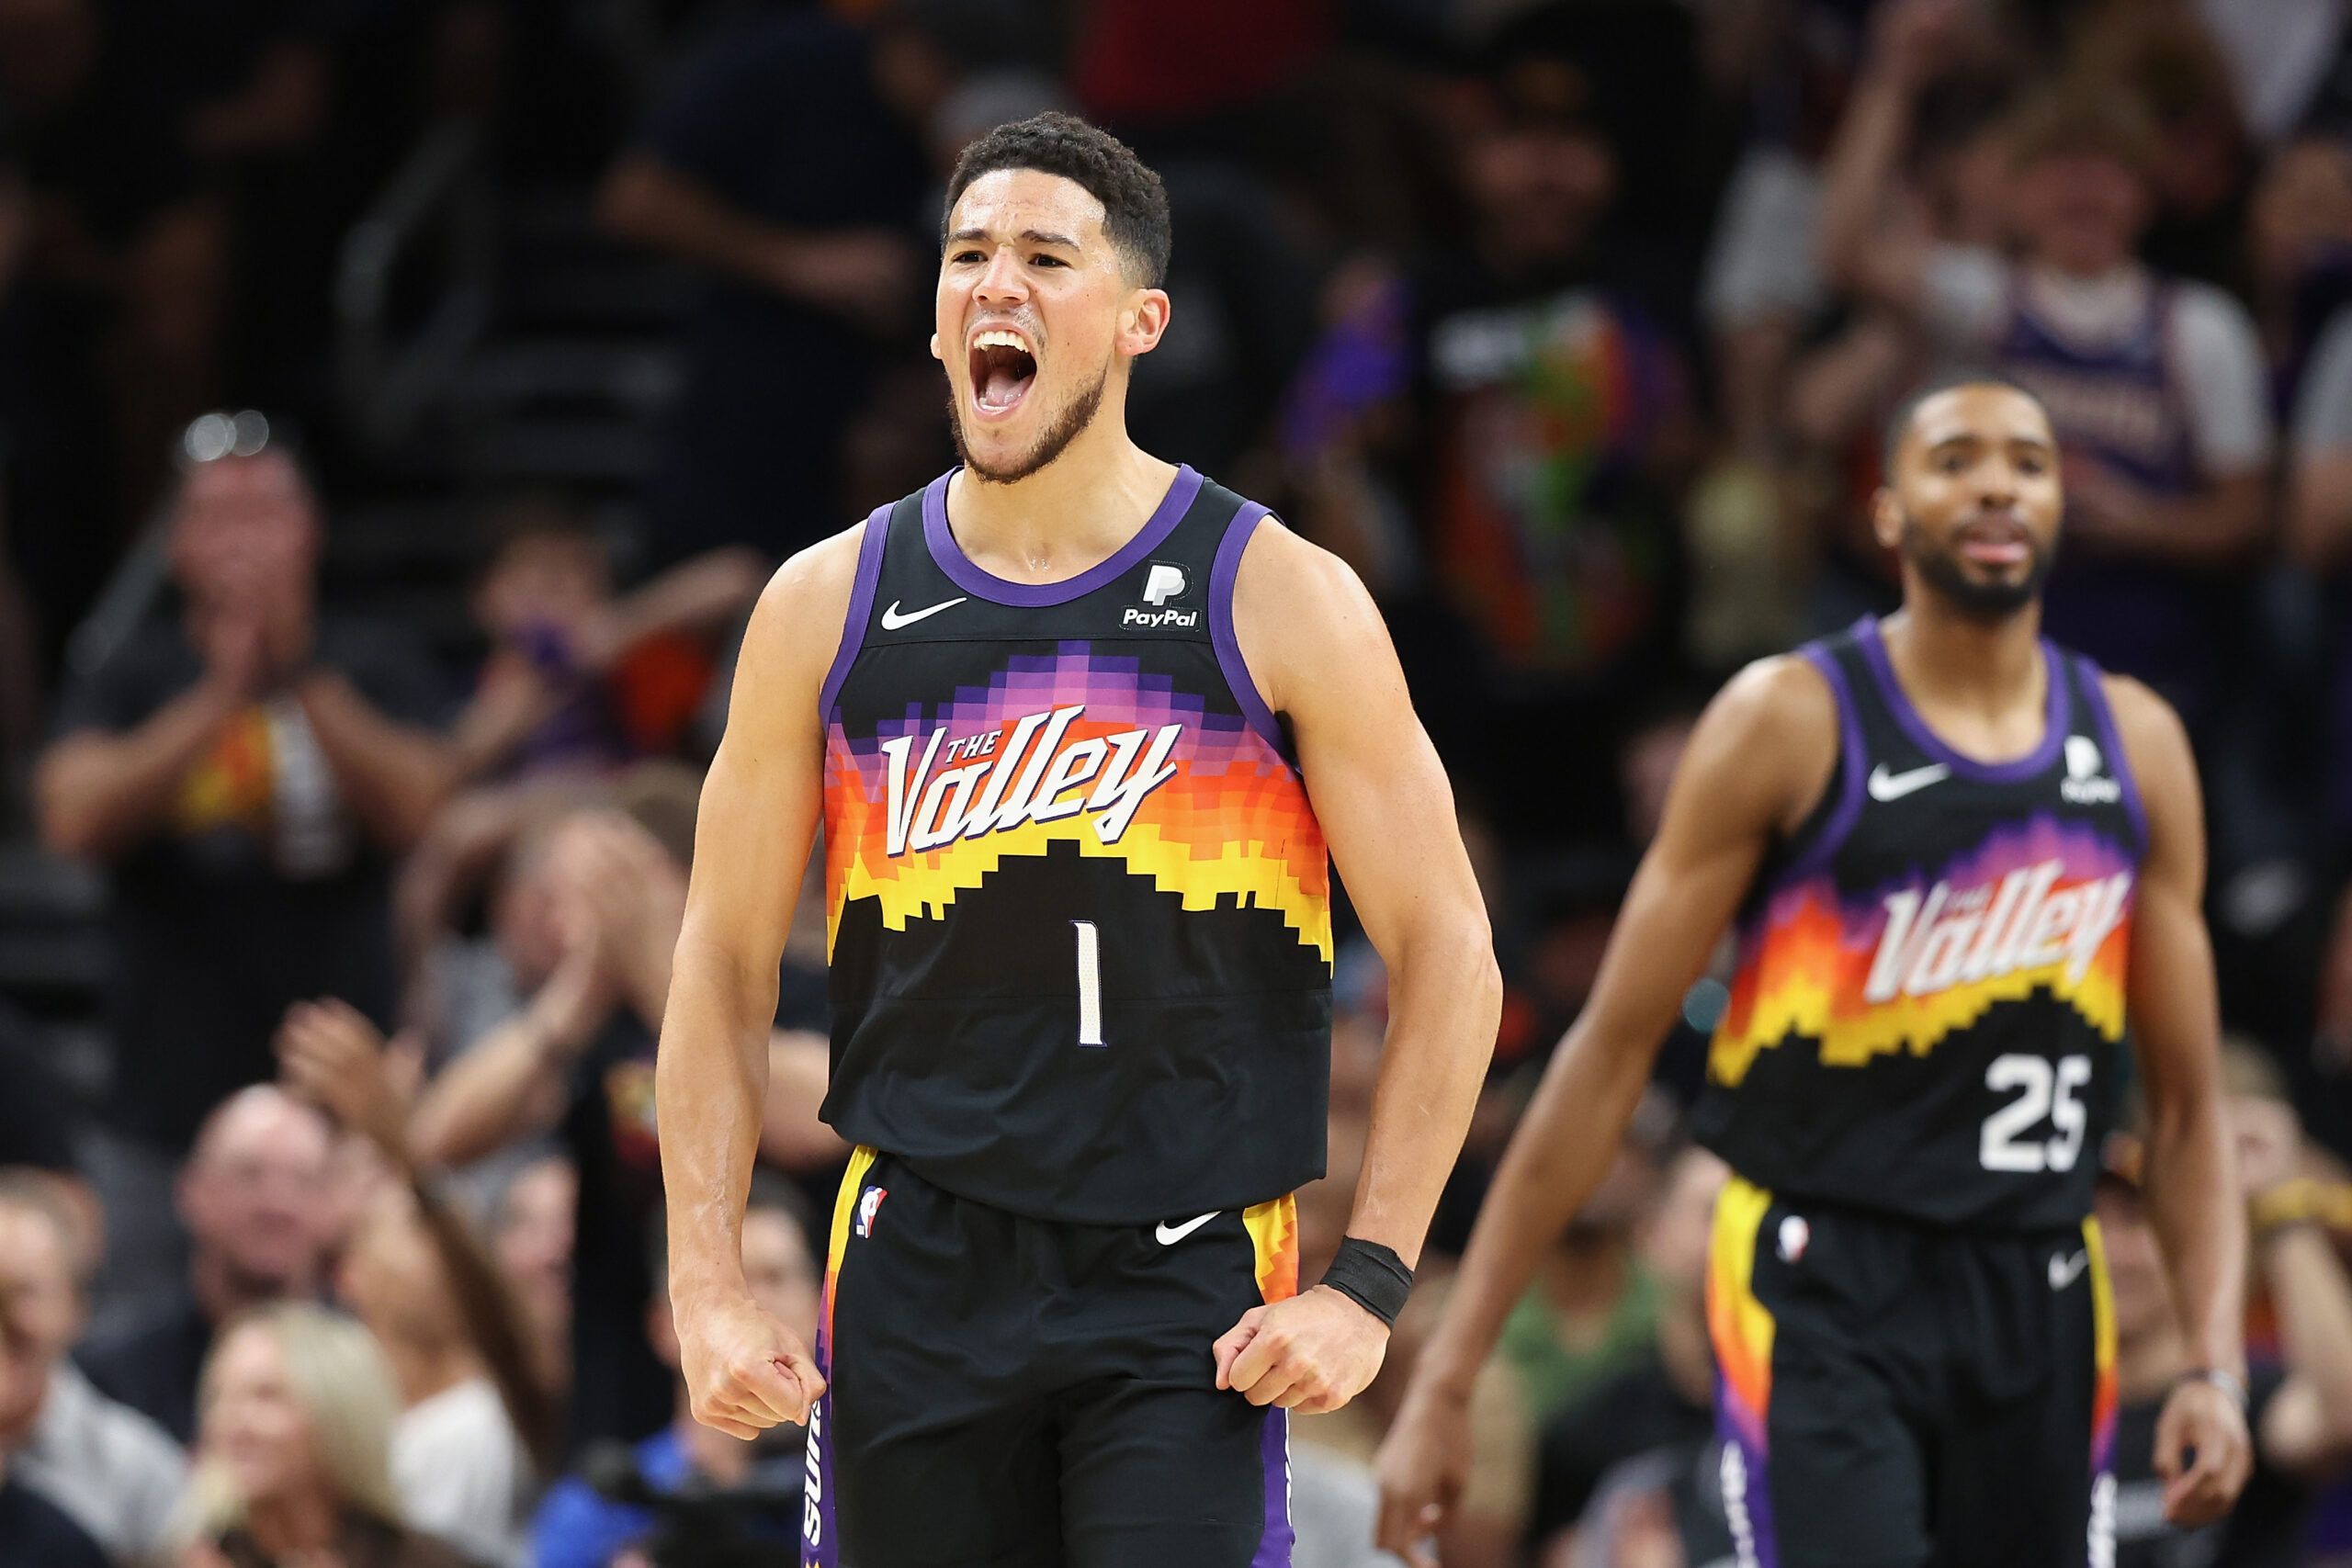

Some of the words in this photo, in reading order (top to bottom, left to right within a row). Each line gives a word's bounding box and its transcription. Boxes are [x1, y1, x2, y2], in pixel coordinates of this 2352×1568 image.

[1123, 609, 1197, 627] PayPal
[882, 705, 1182, 858] Valley
[947, 729, 1001, 763] THE
[1071, 920, 1106, 1047] 1
[1864, 859, 2132, 1002] Valley
[1979, 1054, 2092, 1172] 25
